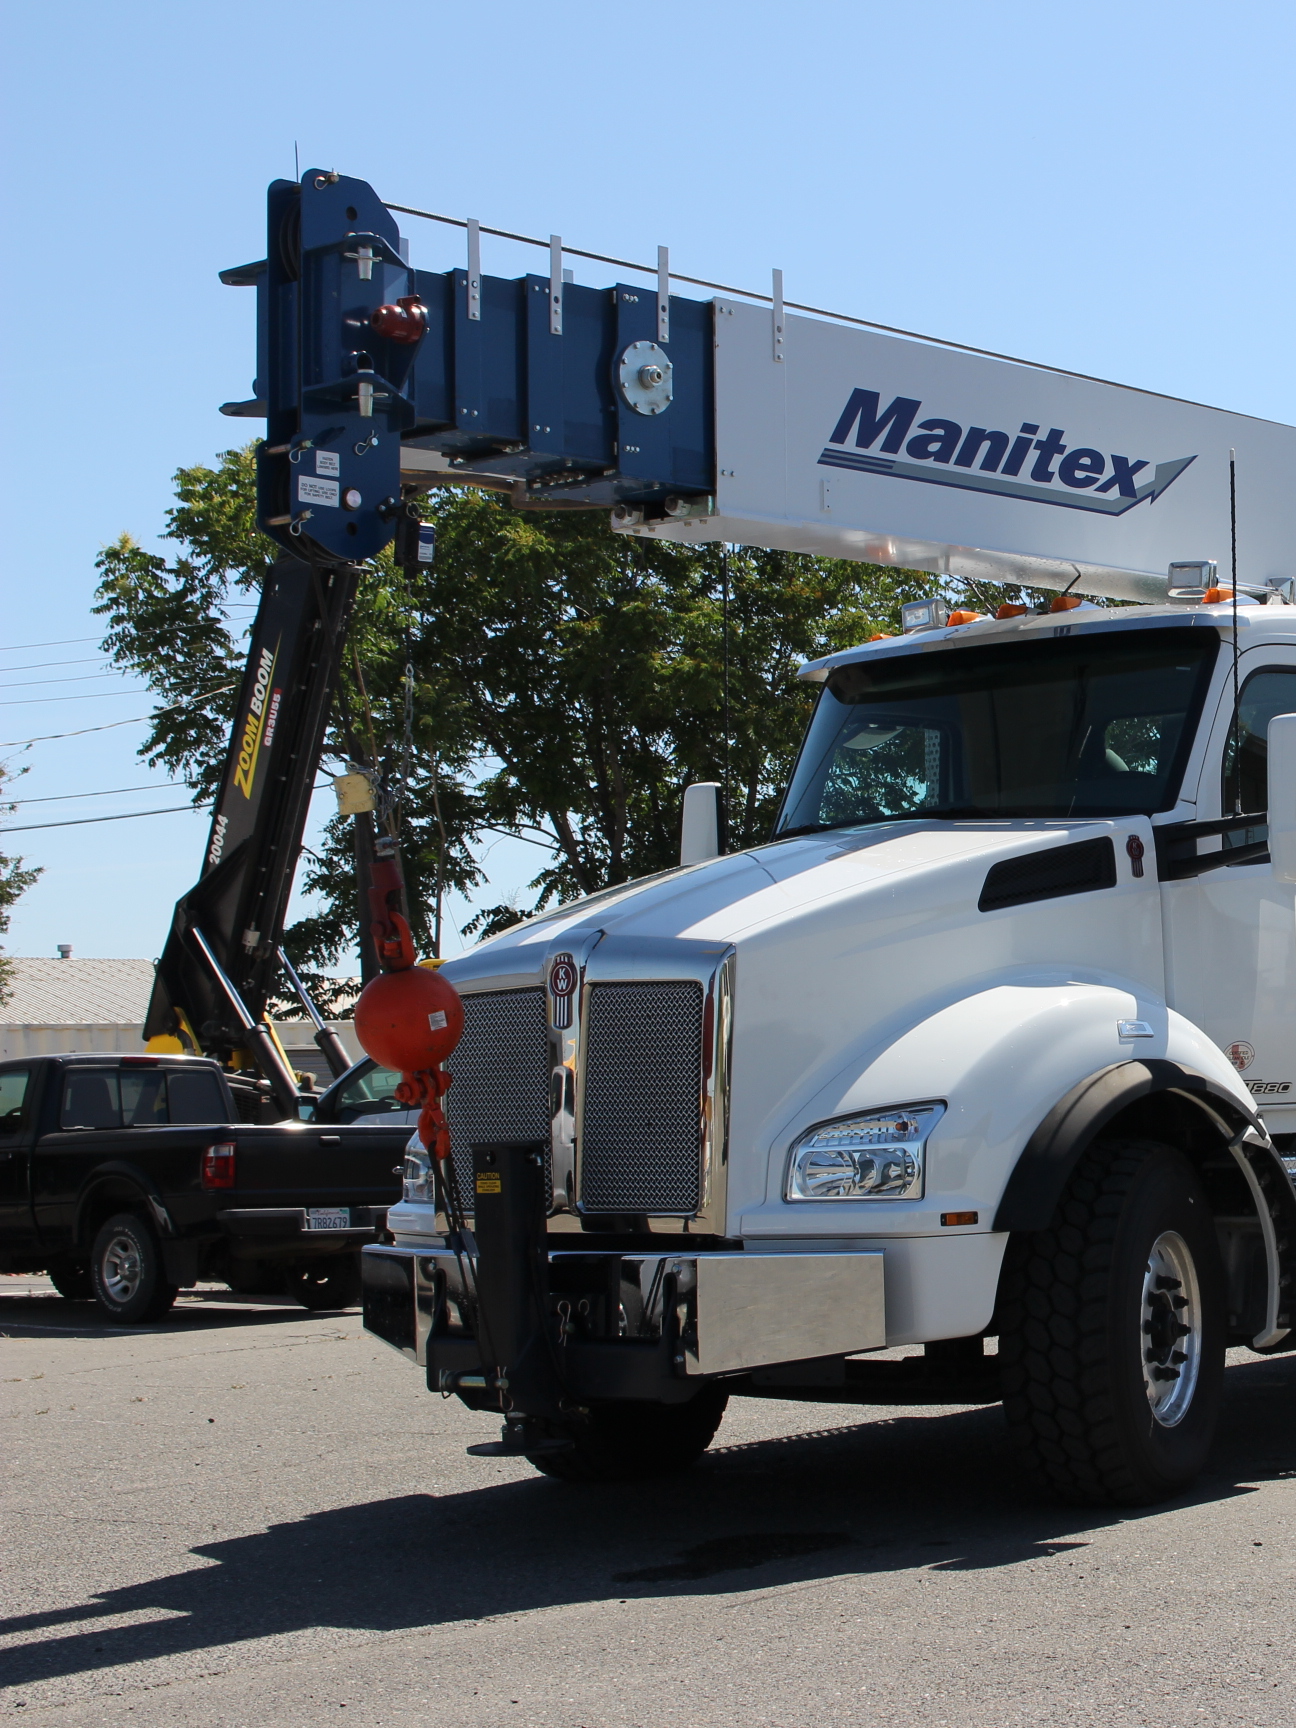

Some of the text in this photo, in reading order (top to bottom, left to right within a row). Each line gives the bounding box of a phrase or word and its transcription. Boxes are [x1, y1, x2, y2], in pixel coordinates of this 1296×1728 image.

[828, 387, 1150, 499] Manitex
[234, 648, 274, 800] ZOOM BOOM
[209, 814, 229, 865] 20044
[1243, 1079, 1292, 1094] T880
[476, 1172, 500, 1180] CAUTION
[312, 1216, 348, 1229] 7R82679
